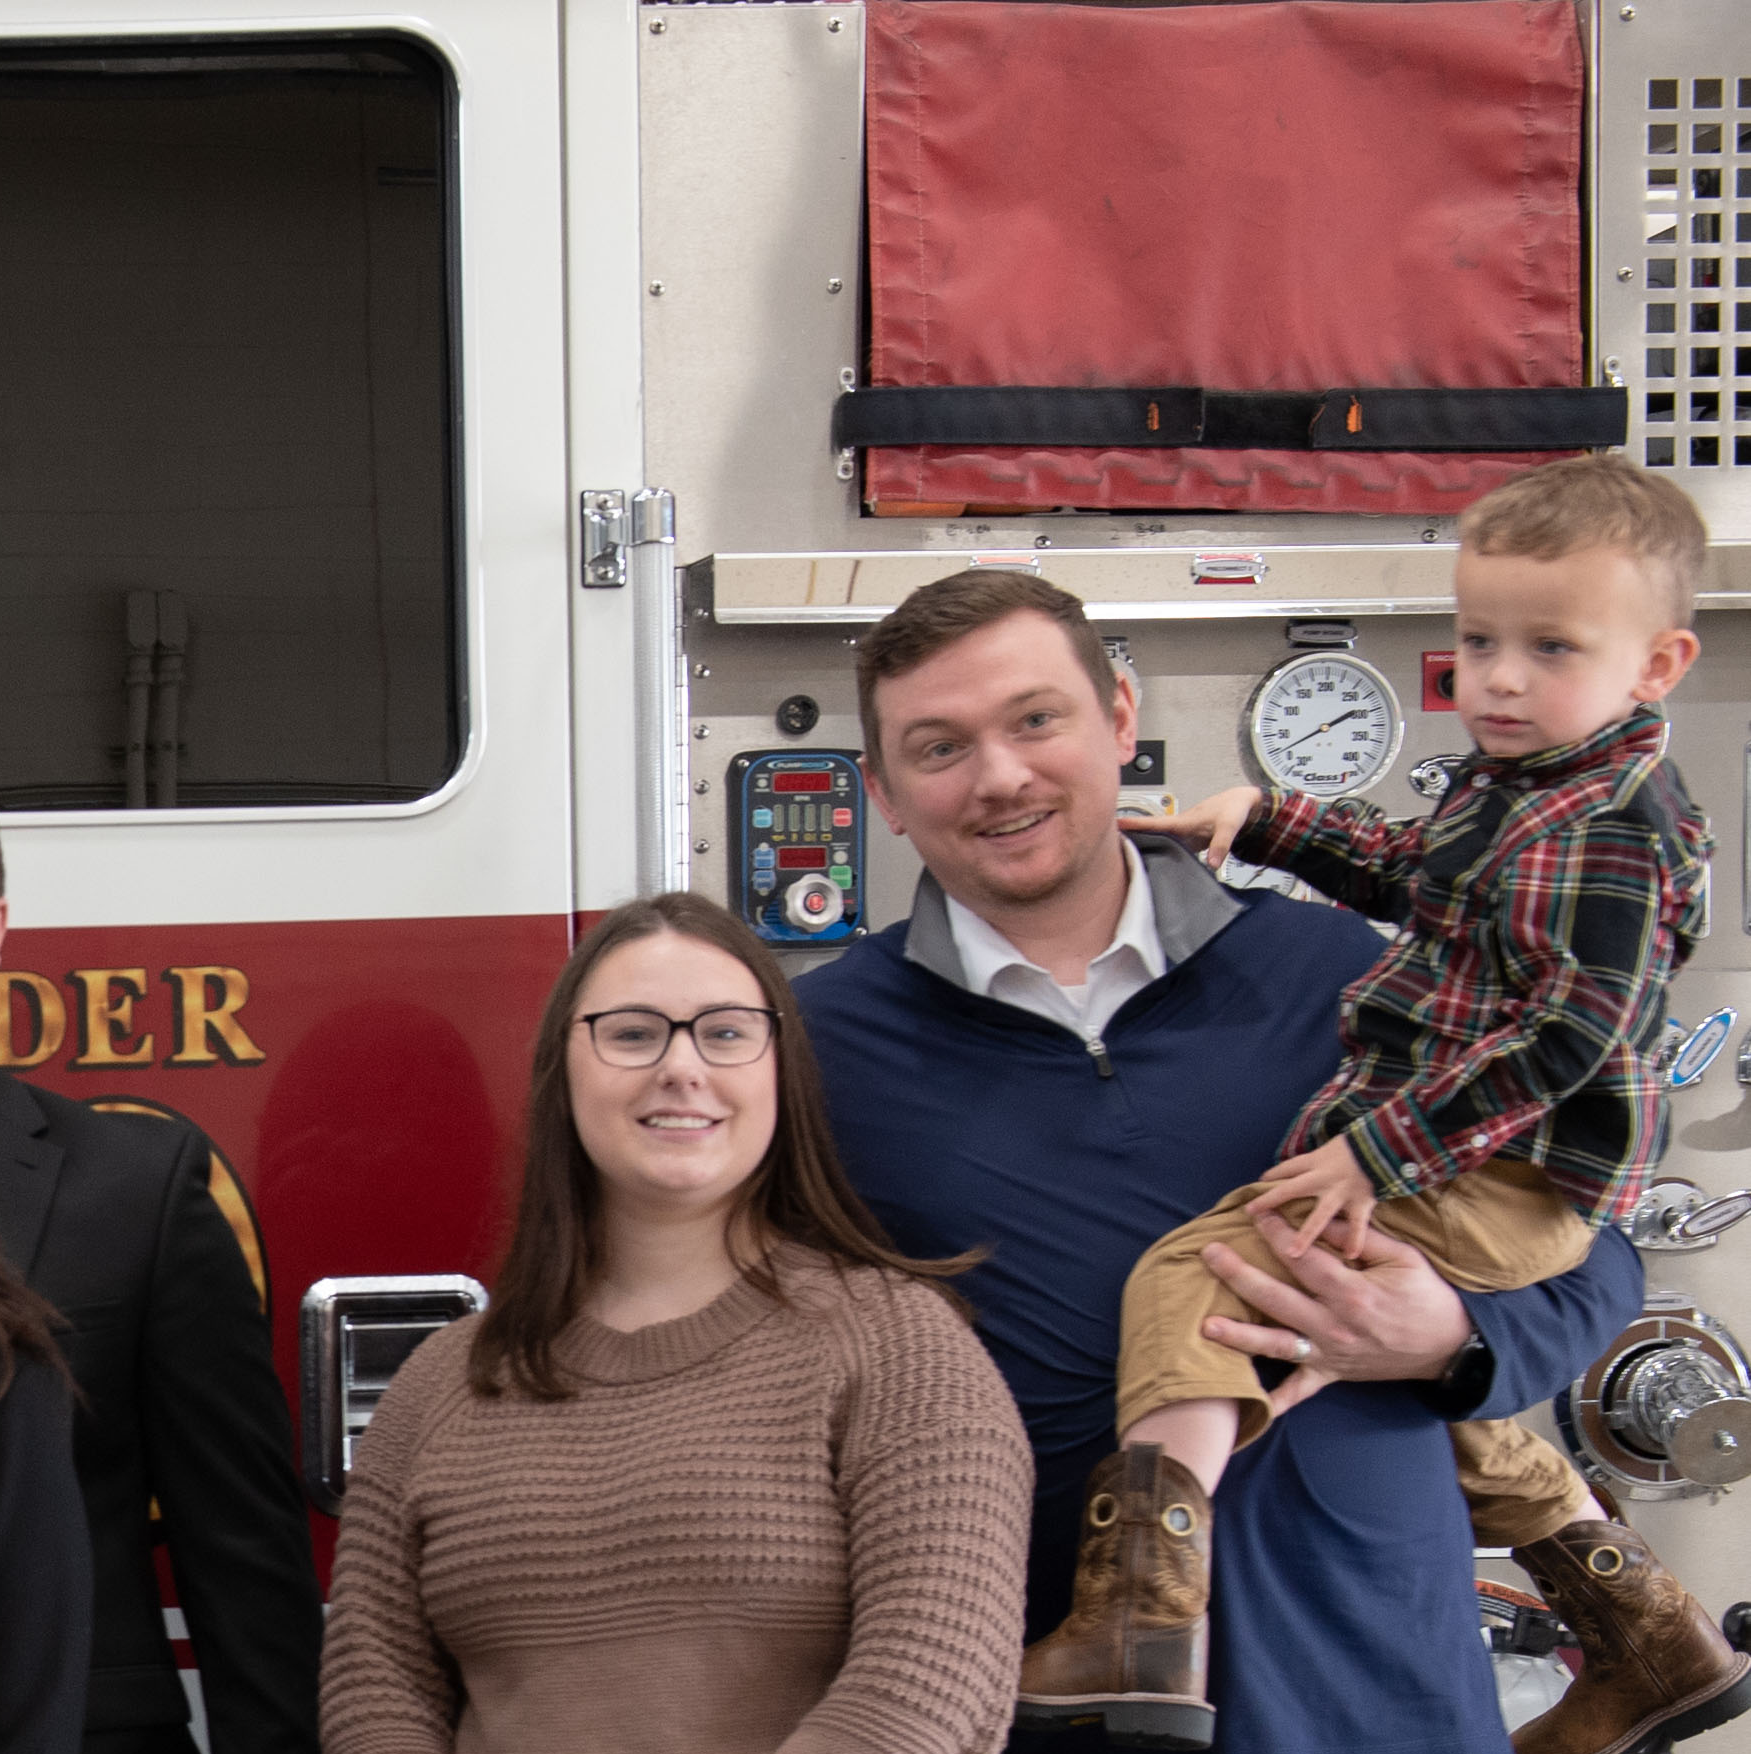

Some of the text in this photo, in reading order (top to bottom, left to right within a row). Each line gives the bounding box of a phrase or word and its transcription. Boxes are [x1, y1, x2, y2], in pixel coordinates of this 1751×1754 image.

[1317, 682, 1335, 692] 200
[1296, 689, 1313, 699] 150
[1341, 691, 1359, 701] 250
[1284, 706, 1299, 716] 100
[1278, 729, 1290, 739] 50
[1352, 731, 1369, 741] 350
[1342, 752, 1359, 762] 400
